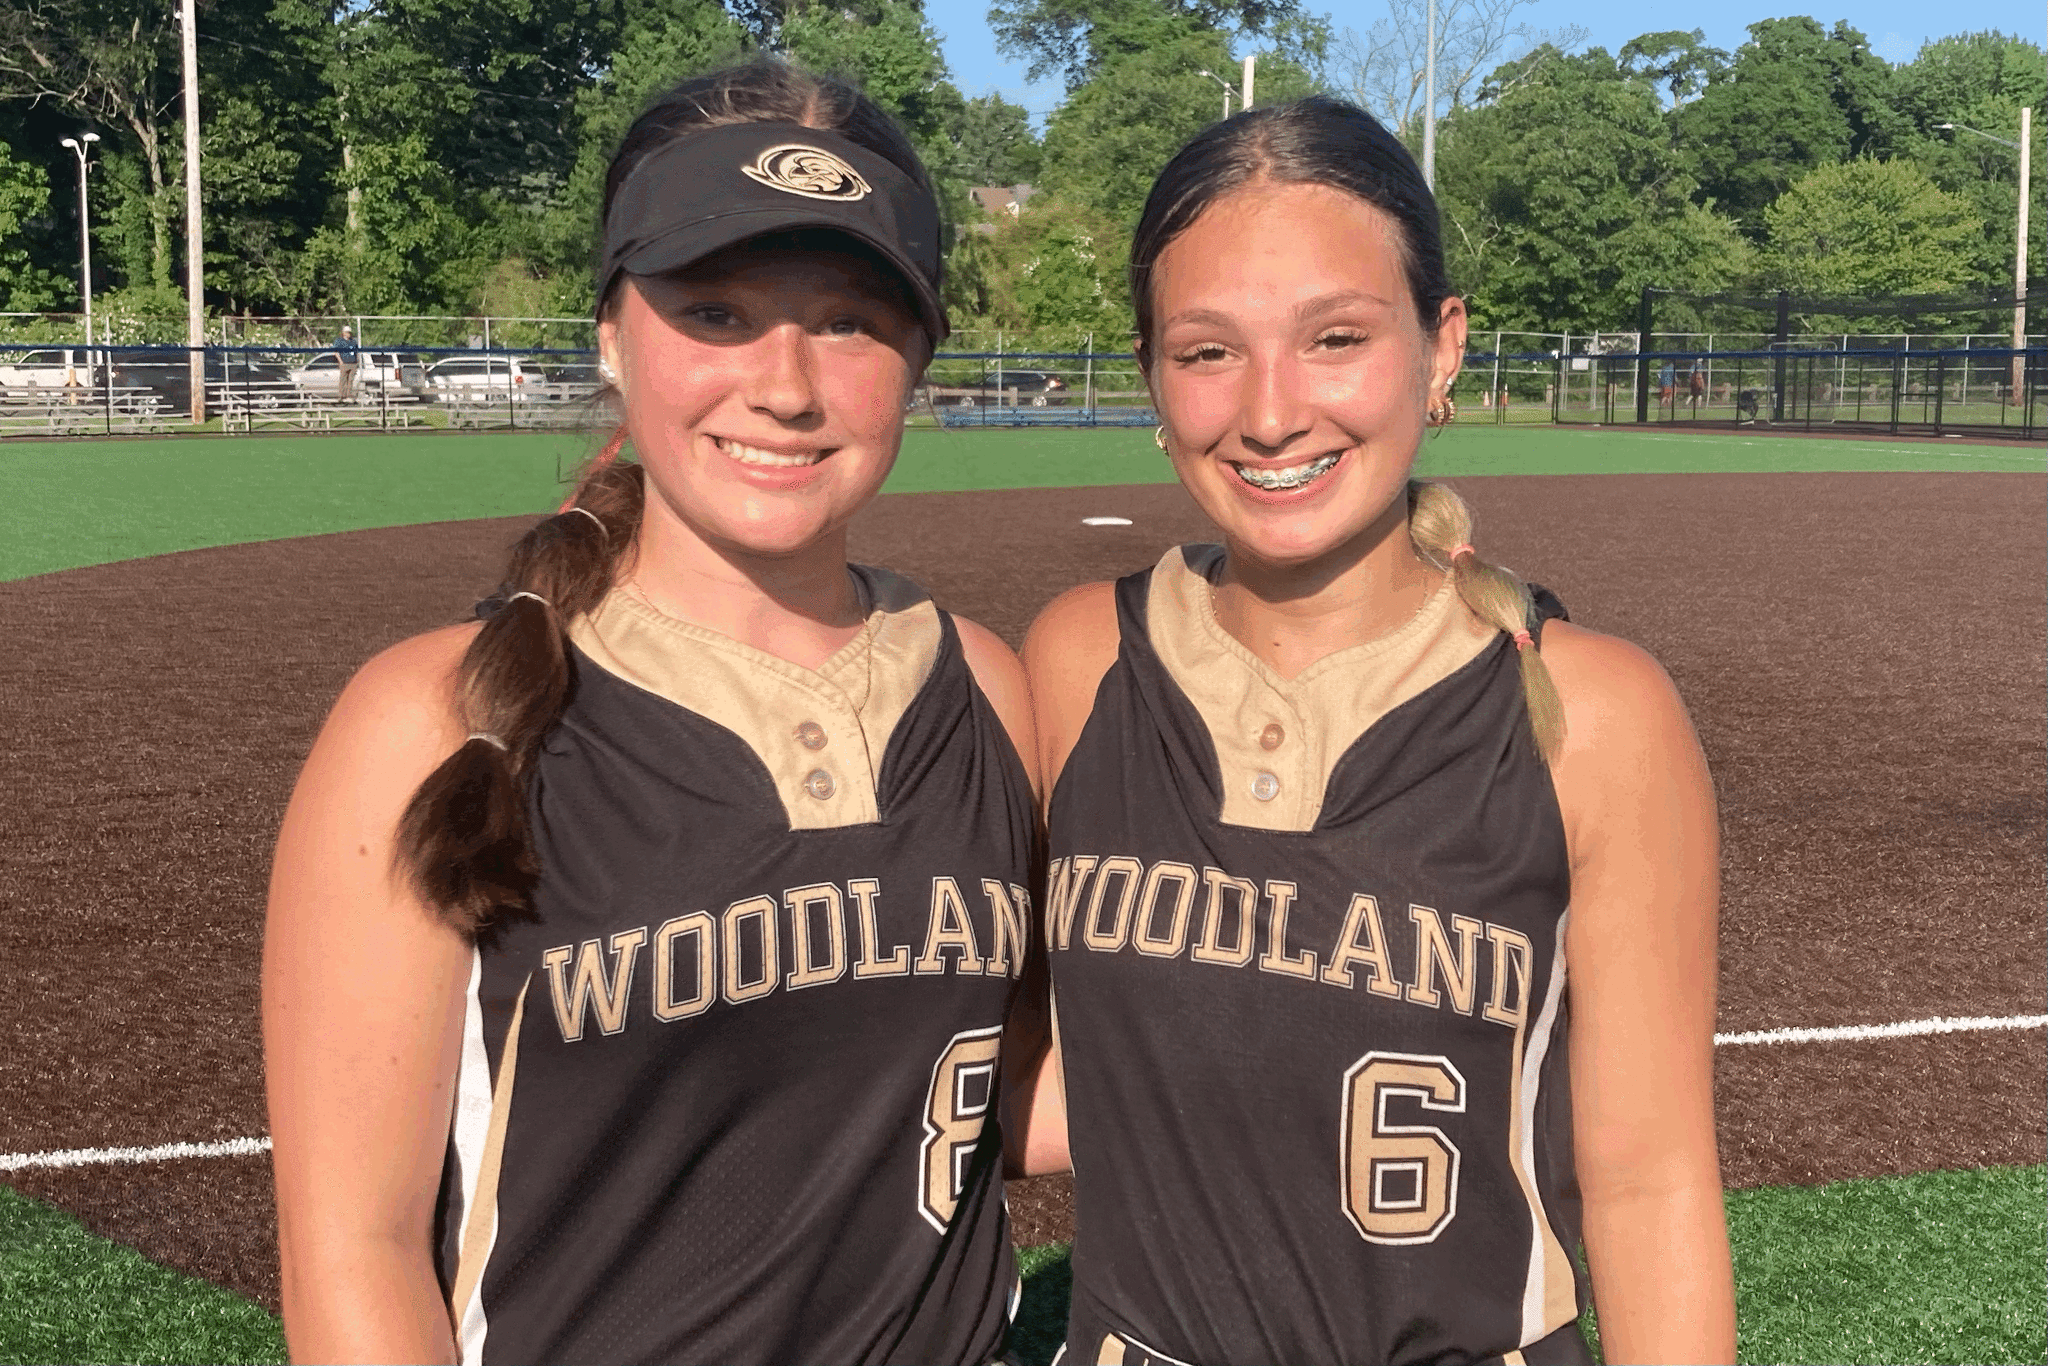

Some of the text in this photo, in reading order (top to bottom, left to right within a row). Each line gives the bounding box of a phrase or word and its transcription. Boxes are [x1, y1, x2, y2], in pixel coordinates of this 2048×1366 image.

[542, 875, 1033, 1043] WOODLAN
[1045, 854, 1533, 1029] WOODLAND
[917, 1024, 1004, 1236] 8
[1339, 1050, 1467, 1246] 6
